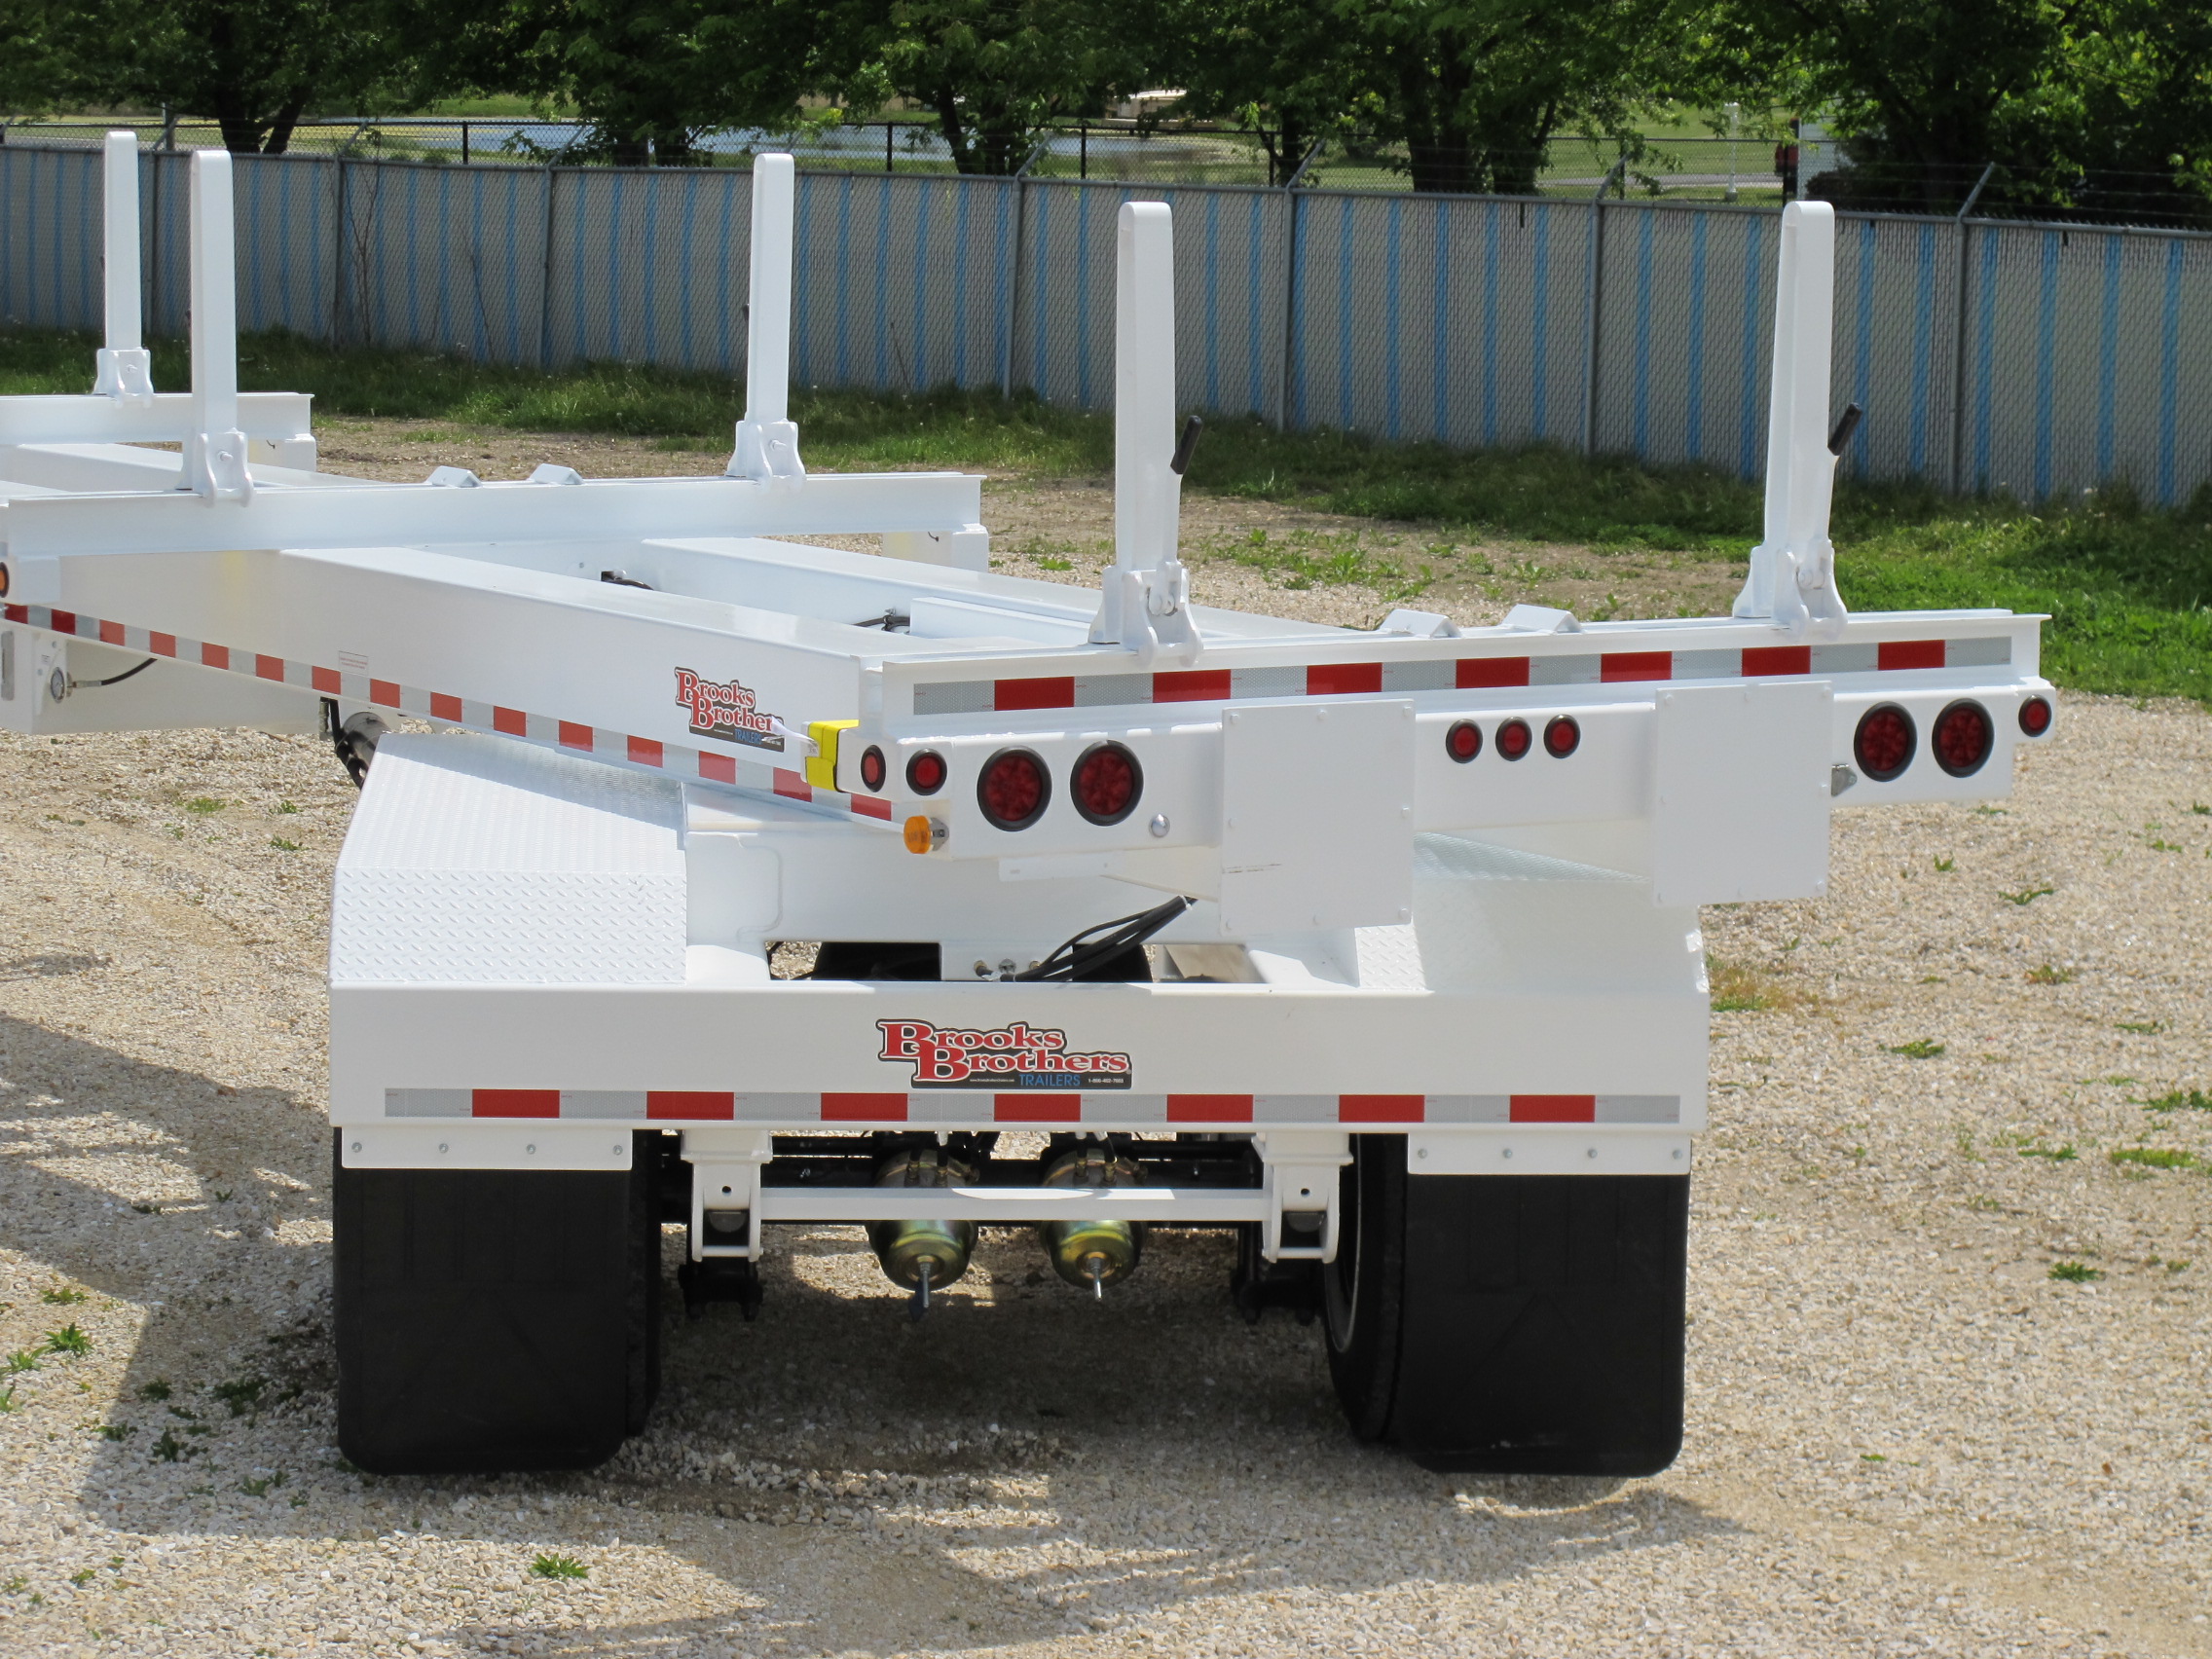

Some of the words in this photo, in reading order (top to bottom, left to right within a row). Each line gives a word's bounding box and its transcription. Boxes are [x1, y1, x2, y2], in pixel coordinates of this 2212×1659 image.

[675, 670, 756, 707] Brooks
[689, 689, 776, 731] Brother
[878, 1021, 1064, 1057] Brooks
[914, 1039, 1130, 1082] Brothers
[1019, 1074, 1081, 1087] TRAILERS
